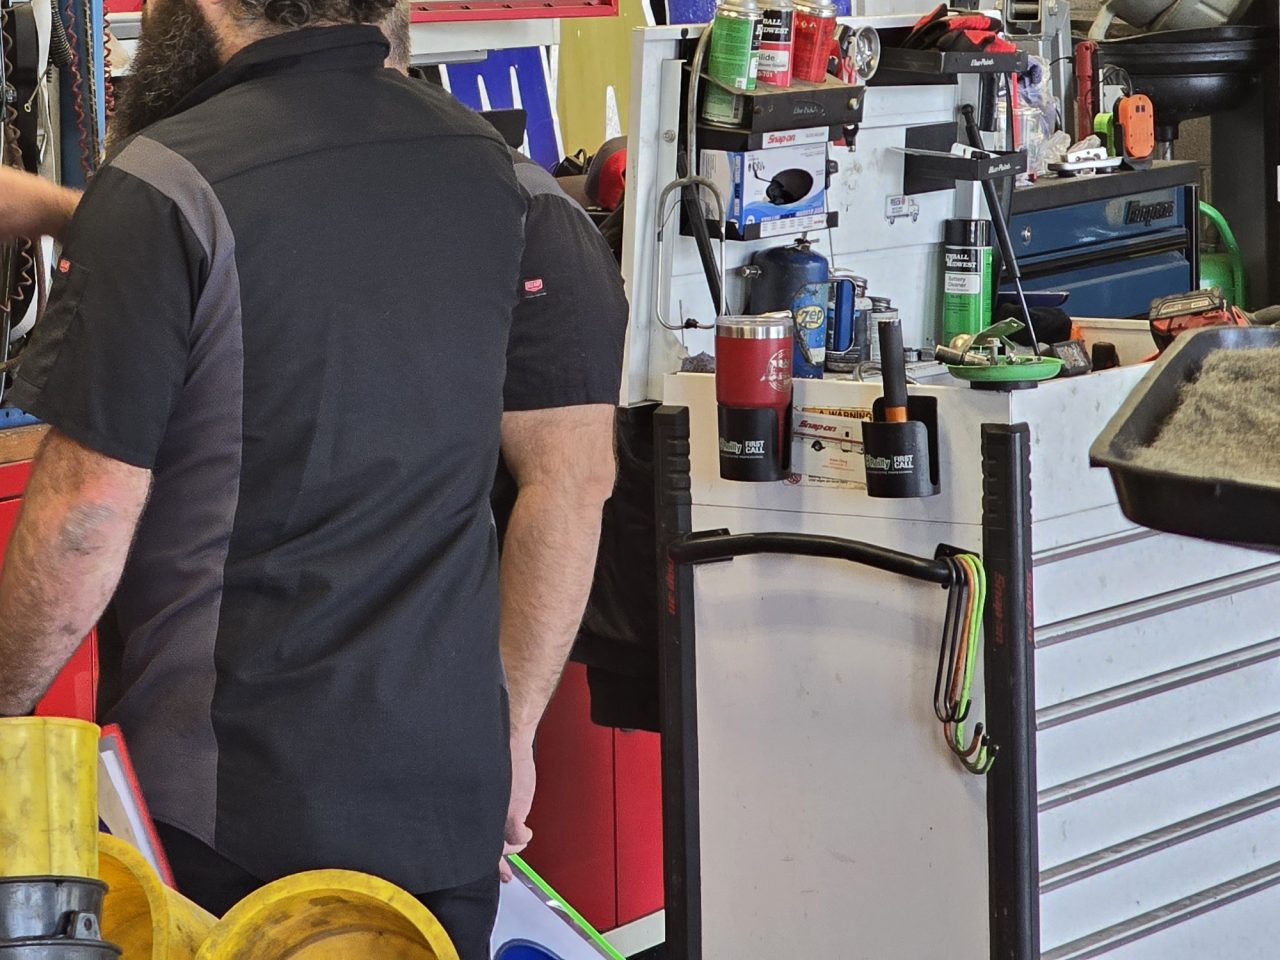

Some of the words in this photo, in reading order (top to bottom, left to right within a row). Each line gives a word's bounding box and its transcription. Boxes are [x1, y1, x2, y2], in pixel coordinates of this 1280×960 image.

[767, 134, 796, 144] Snap-on
[799, 420, 837, 433] Snap-on
[745, 446, 765, 454] CALL
[894, 461, 914, 469] CALL
